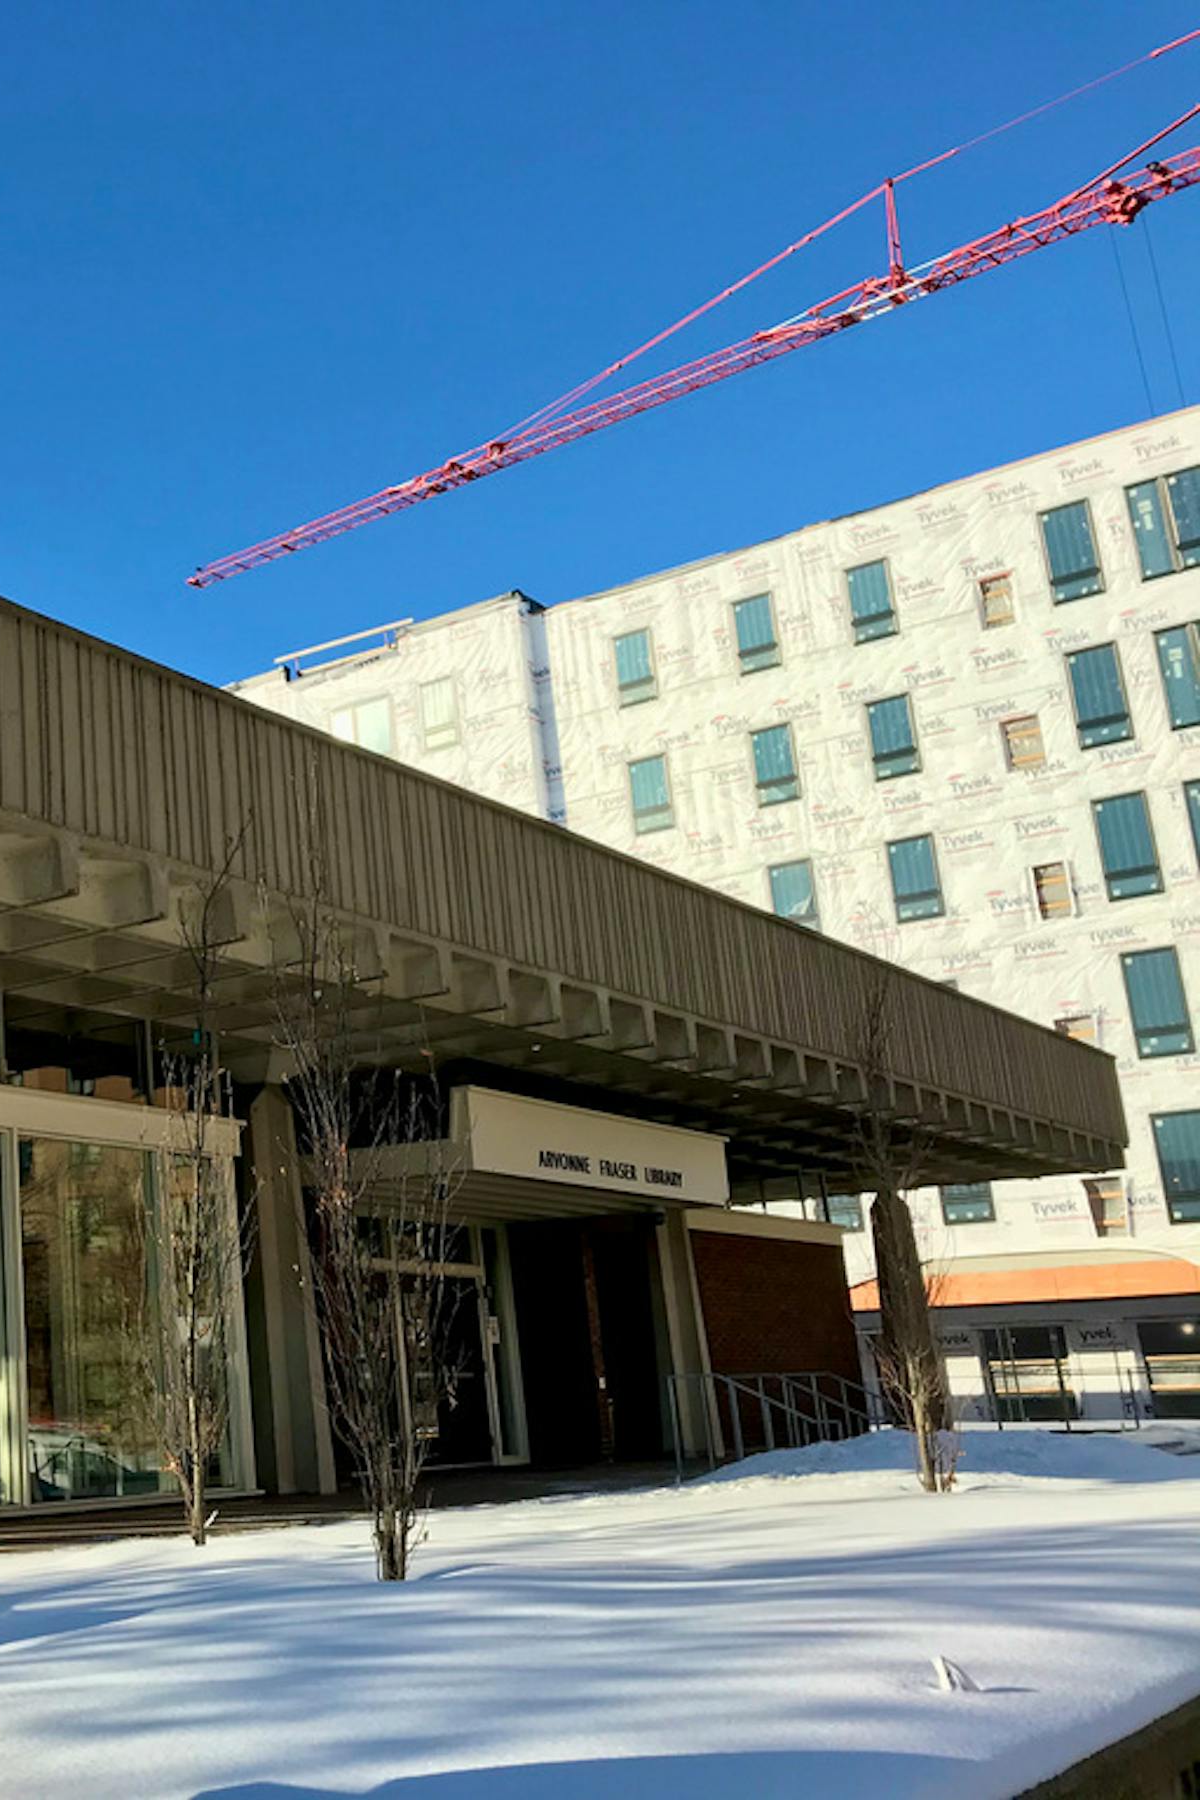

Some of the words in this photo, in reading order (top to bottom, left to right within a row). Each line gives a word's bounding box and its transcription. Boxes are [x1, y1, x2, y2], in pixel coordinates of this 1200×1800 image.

[1134, 435, 1181, 460] Tyvek
[1059, 459, 1103, 483] Tyvek
[986, 481, 1030, 503] Tyvek
[917, 502, 958, 524] Tyvek
[853, 523, 891, 545] Tyvek
[962, 556, 1007, 577] Tyvek
[899, 577, 935, 600] yvek
[1121, 609, 1168, 630] Tyvek
[1045, 629, 1090, 649] Tyvek
[972, 649, 1017, 669] Tyvek
[904, 667, 945, 687] Tyvek
[972, 699, 1017, 719] Tyvek
[951, 773, 992, 793] Tyvek
[883, 791, 922, 809] Tyvek
[1014, 815, 1058, 835] Tyvek
[942, 830, 984, 848] Tyvek
[539, 1151, 591, 1174] ARVONNE
[600, 1160, 637, 1181] FRASER
[645, 1168, 682, 1187] LIBRARY
[1032, 1198, 1079, 1217] Tyvek
